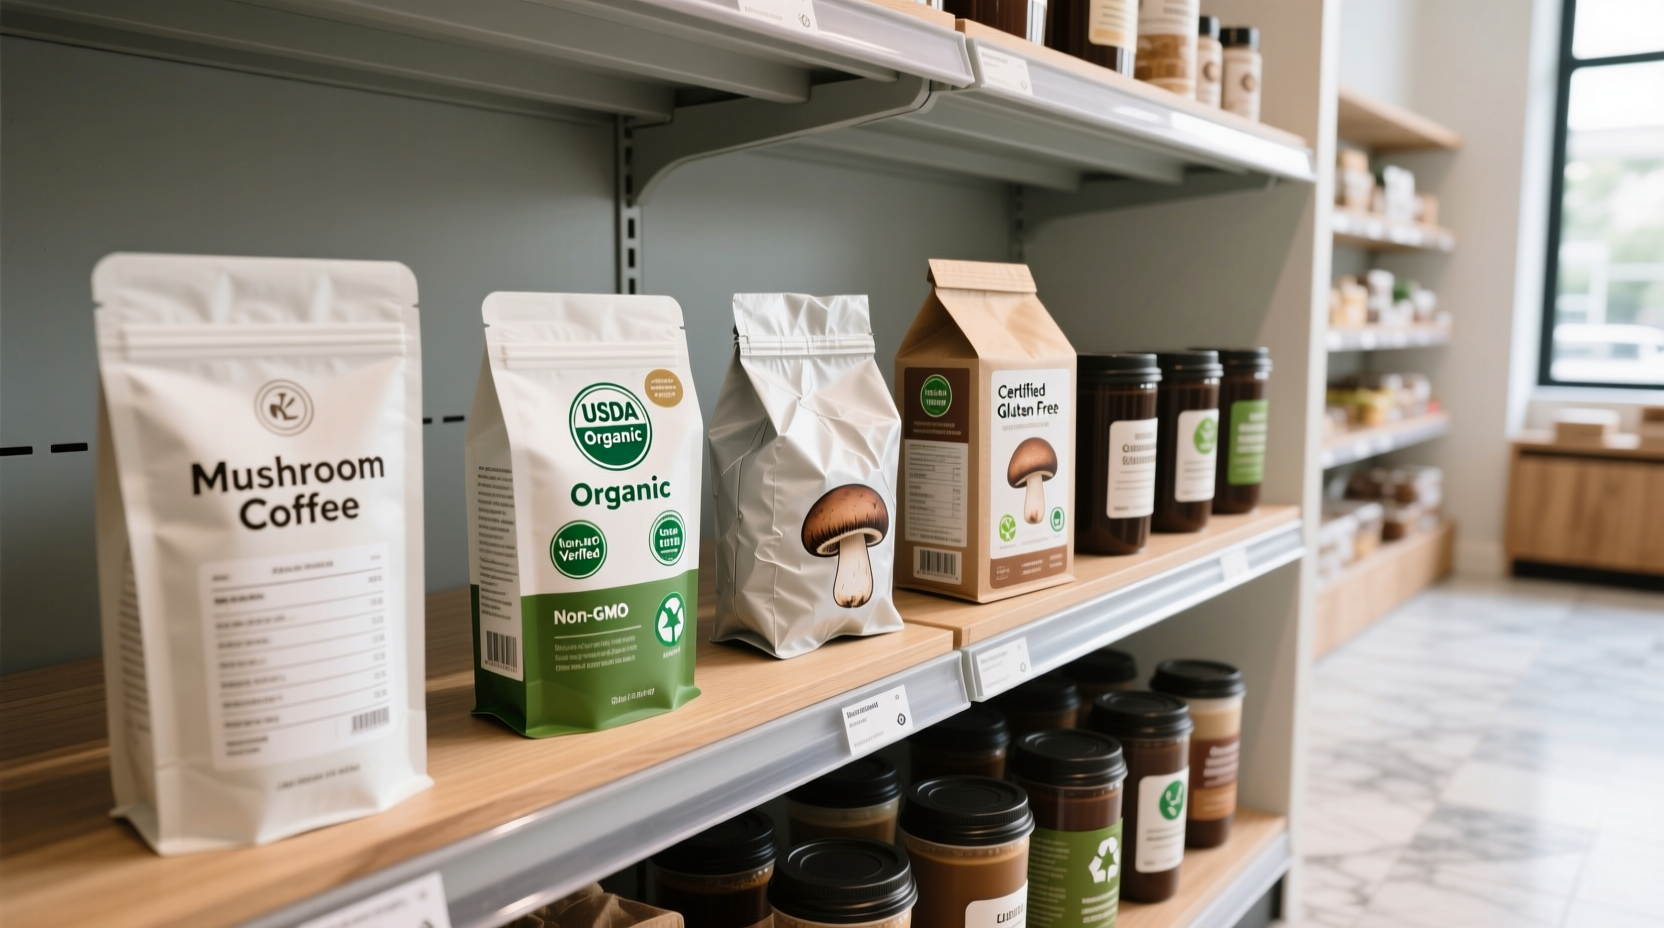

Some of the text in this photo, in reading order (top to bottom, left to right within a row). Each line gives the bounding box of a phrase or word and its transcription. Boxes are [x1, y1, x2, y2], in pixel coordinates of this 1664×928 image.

[581, 401, 640, 423] USDA
[997, 400, 1059, 419] Gluten Free
[584, 427, 643, 449] Organic
[191, 455, 385, 495] Mushroom
[570, 475, 671, 511] Organic
[239, 492, 360, 531] Coffee
[553, 602, 629, 625] Non-GMO
